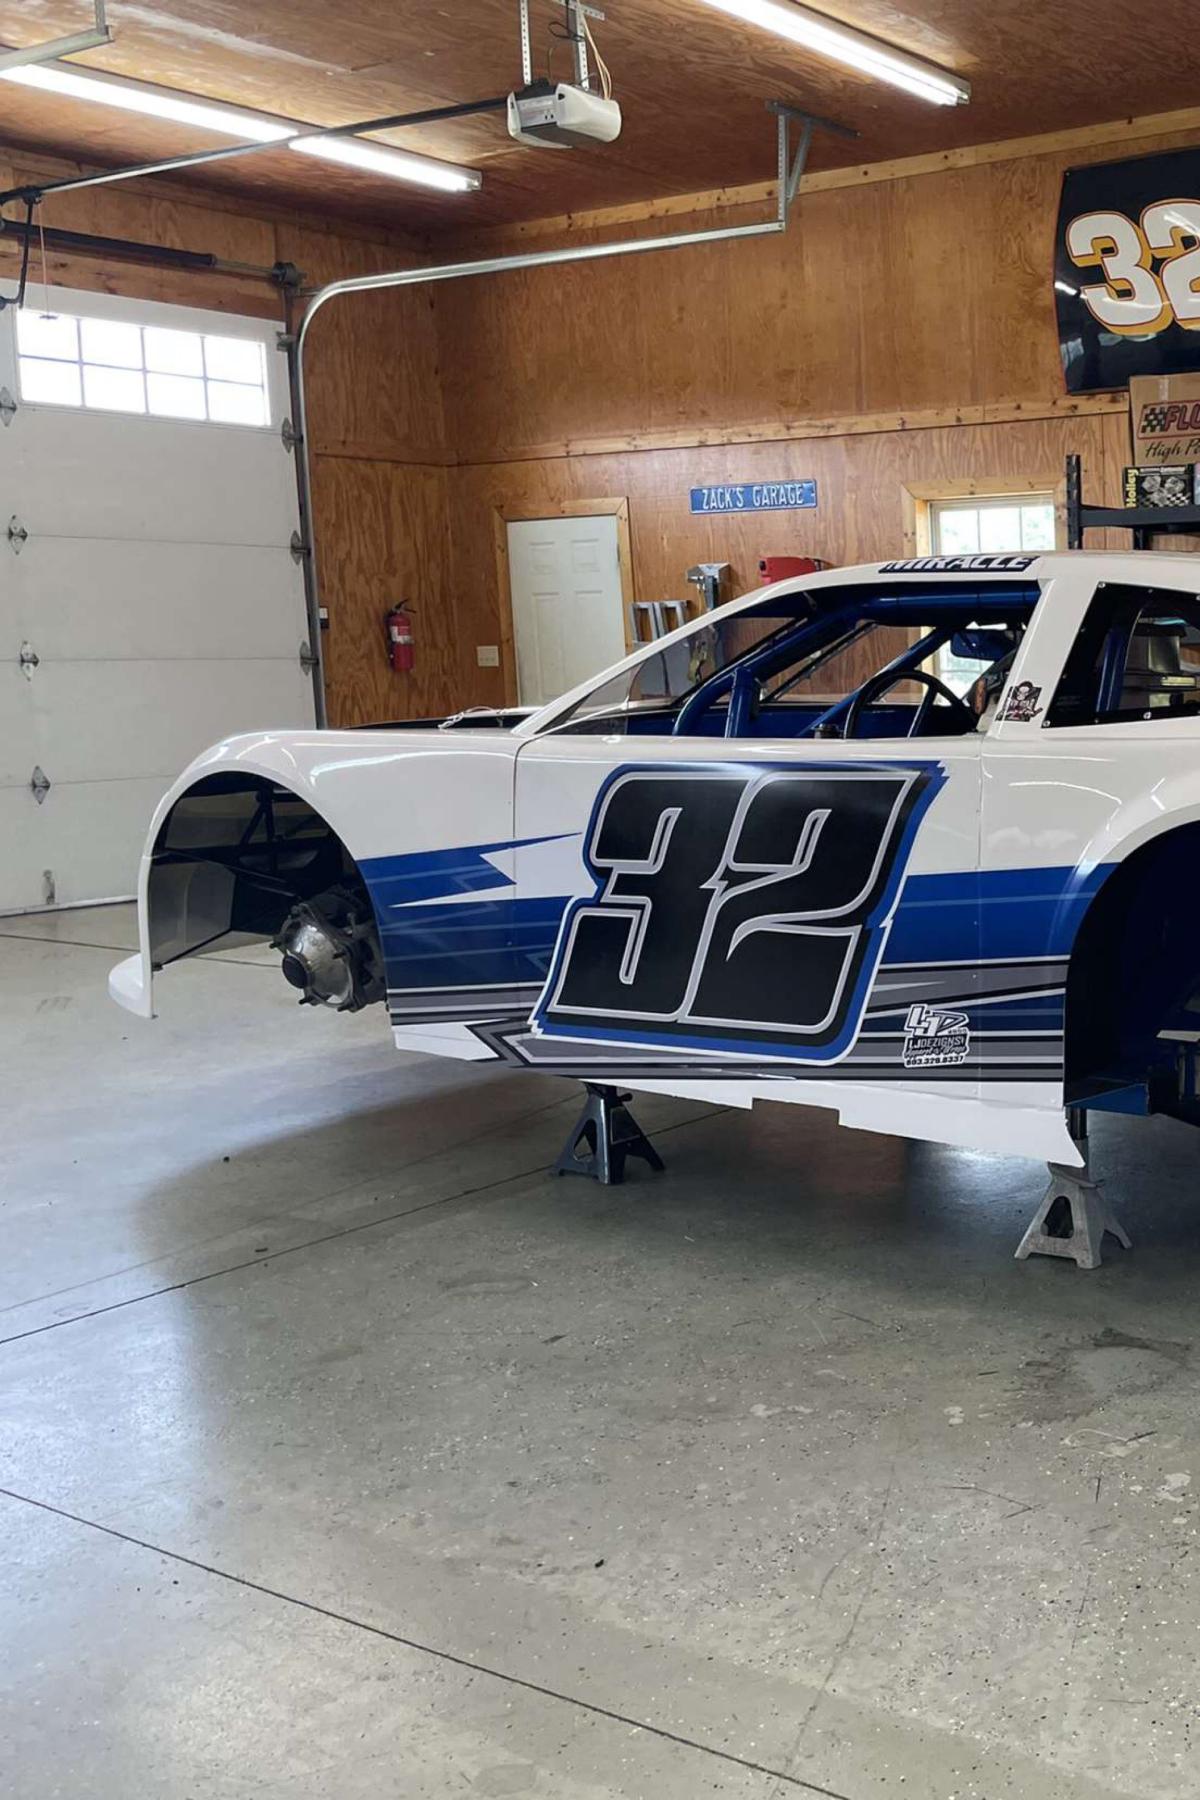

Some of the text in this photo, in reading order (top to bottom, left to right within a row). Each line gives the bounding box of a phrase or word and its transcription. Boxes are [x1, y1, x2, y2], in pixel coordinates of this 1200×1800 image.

[1145, 440, 1182, 463] High
[702, 483, 804, 509] ZACK'S GARAGE
[1126, 469, 1138, 508] Holley
[884, 556, 1036, 571] MIRACLE
[540, 766, 937, 1045] 32
